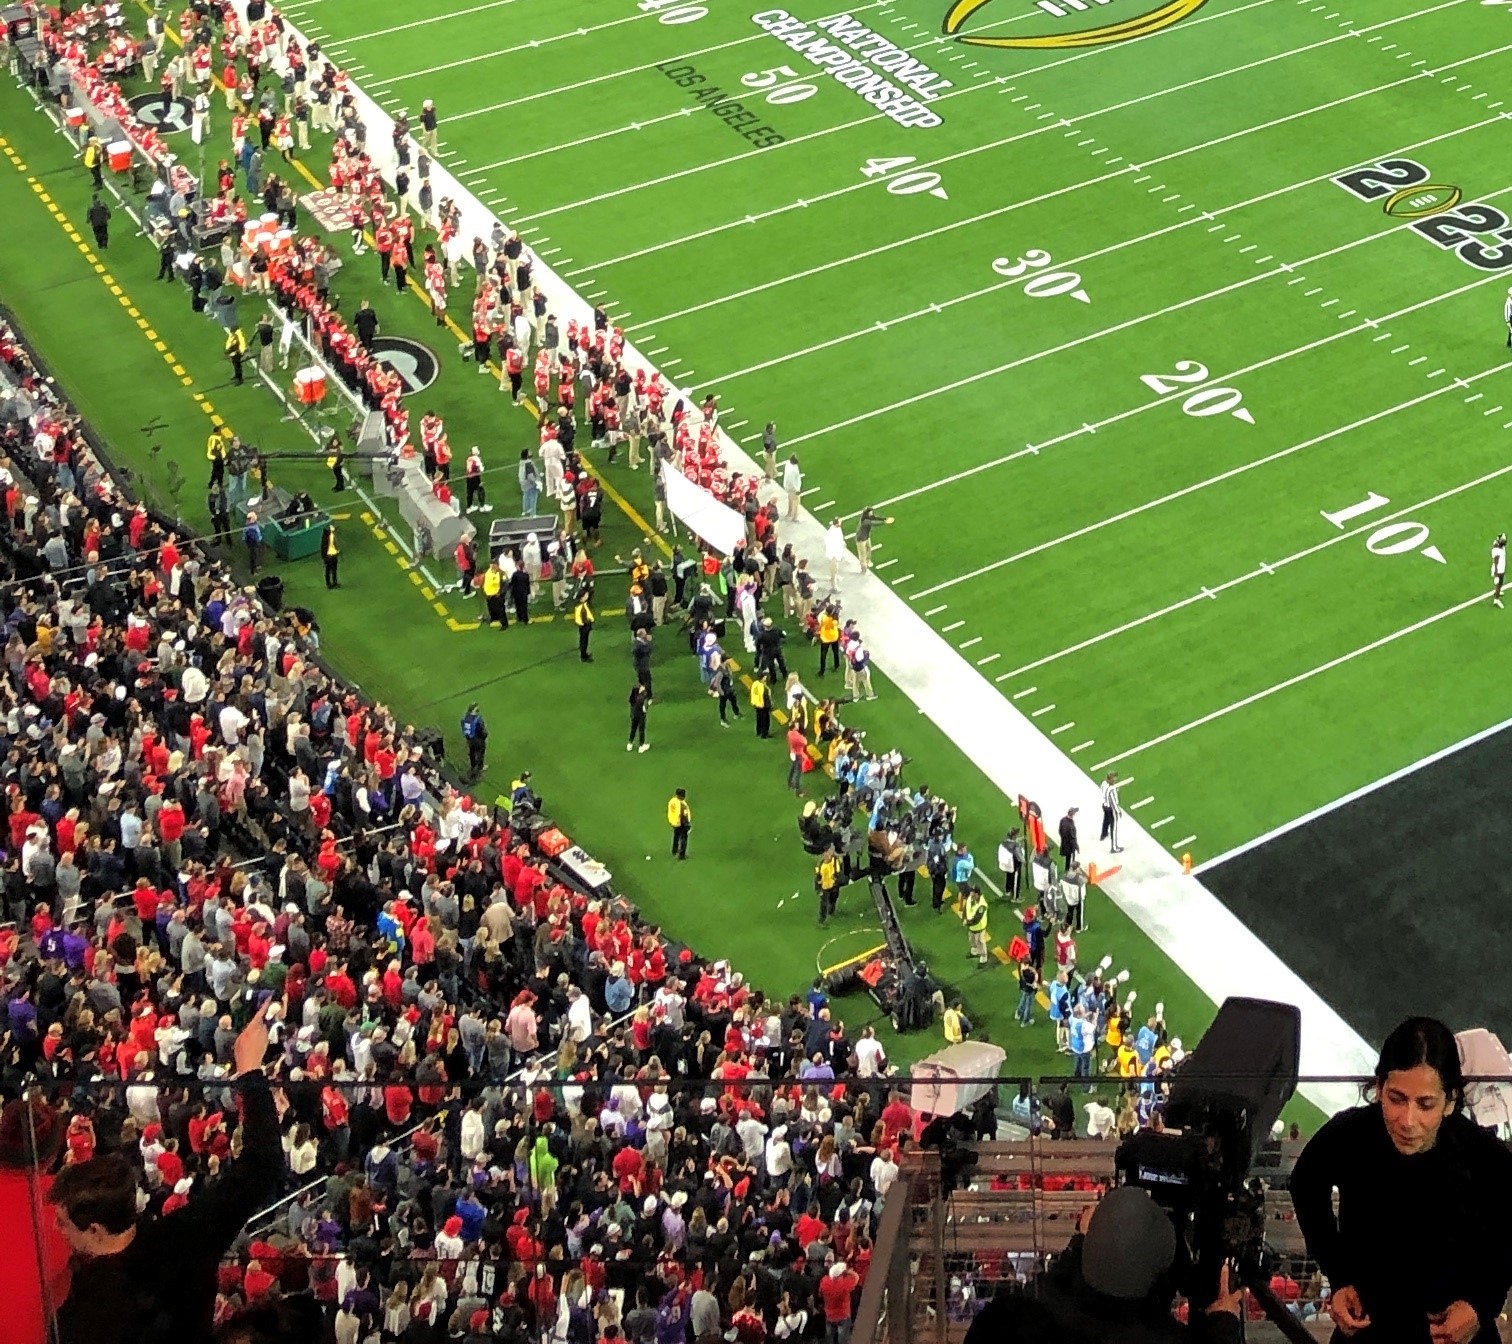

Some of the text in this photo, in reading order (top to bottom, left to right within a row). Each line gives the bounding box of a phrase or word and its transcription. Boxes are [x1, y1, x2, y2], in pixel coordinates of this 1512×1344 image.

[741, 65, 818, 105] 50
[751, 9, 945, 128] CHAMPIONSHIP
[817, 14, 954, 100] NATIONAL
[656, 58, 786, 149] LOS ANGELES
[859, 156, 942, 196] 40
[992, 249, 1082, 300] 30
[1139, 359, 1244, 418] 20
[1321, 491, 1431, 557] 10
